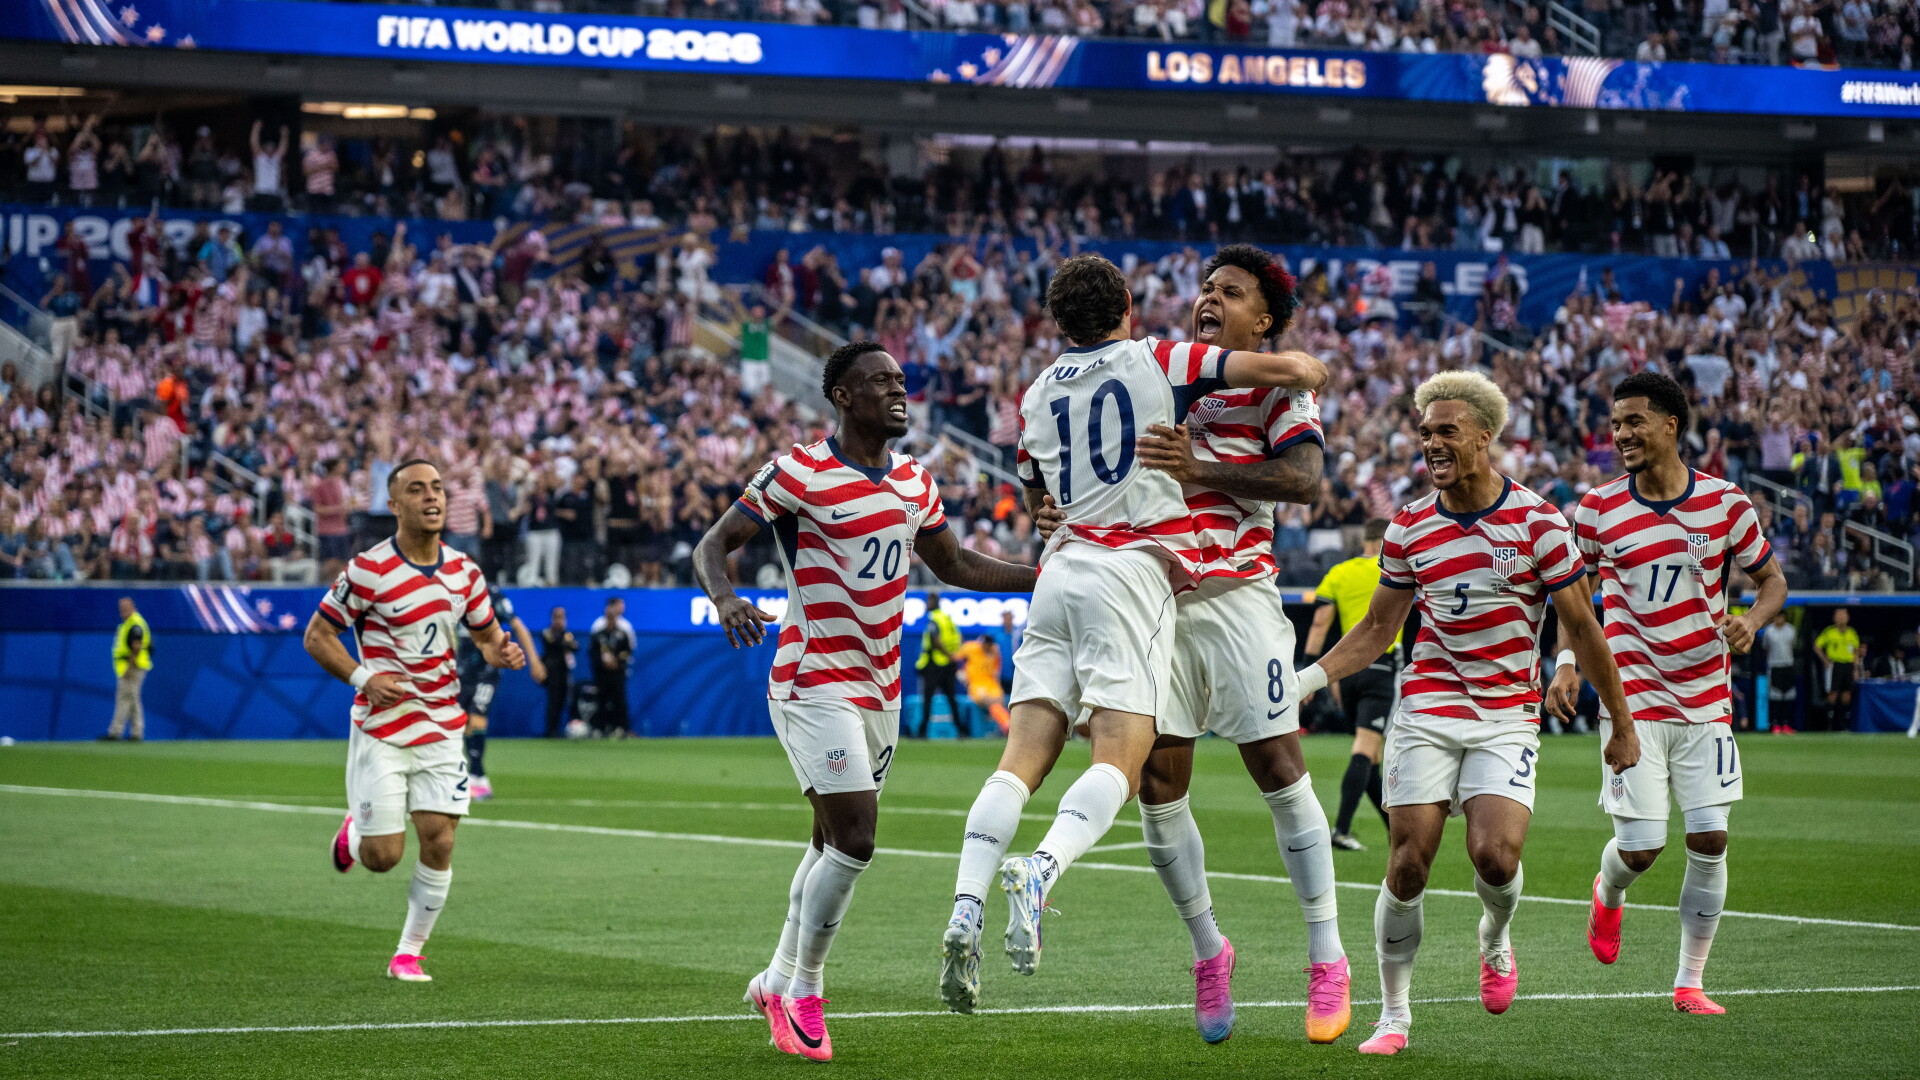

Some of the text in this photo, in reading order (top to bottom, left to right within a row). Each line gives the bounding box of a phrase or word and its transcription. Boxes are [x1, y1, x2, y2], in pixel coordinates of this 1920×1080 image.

[377, 15, 763, 64] FIFA WORLD CUP 2026
[1147, 51, 1366, 89] LOS ANGELES
[1841, 81, 1920, 105] #FIFAWorl
[1203, 398, 1224, 410] USA
[1050, 379, 1135, 505] 10
[1495, 548, 1516, 561] USA
[1690, 534, 1708, 546] USA
[858, 537, 902, 581] 20
[1451, 583, 1470, 615] 5
[1648, 564, 1683, 602] 17
[421, 623, 437, 655] 2
[1267, 658, 1284, 703] 8
[828, 750, 845, 760] USA
[873, 745, 893, 782] 2
[1516, 746, 1535, 778] 5
[1715, 736, 1735, 775] 17
